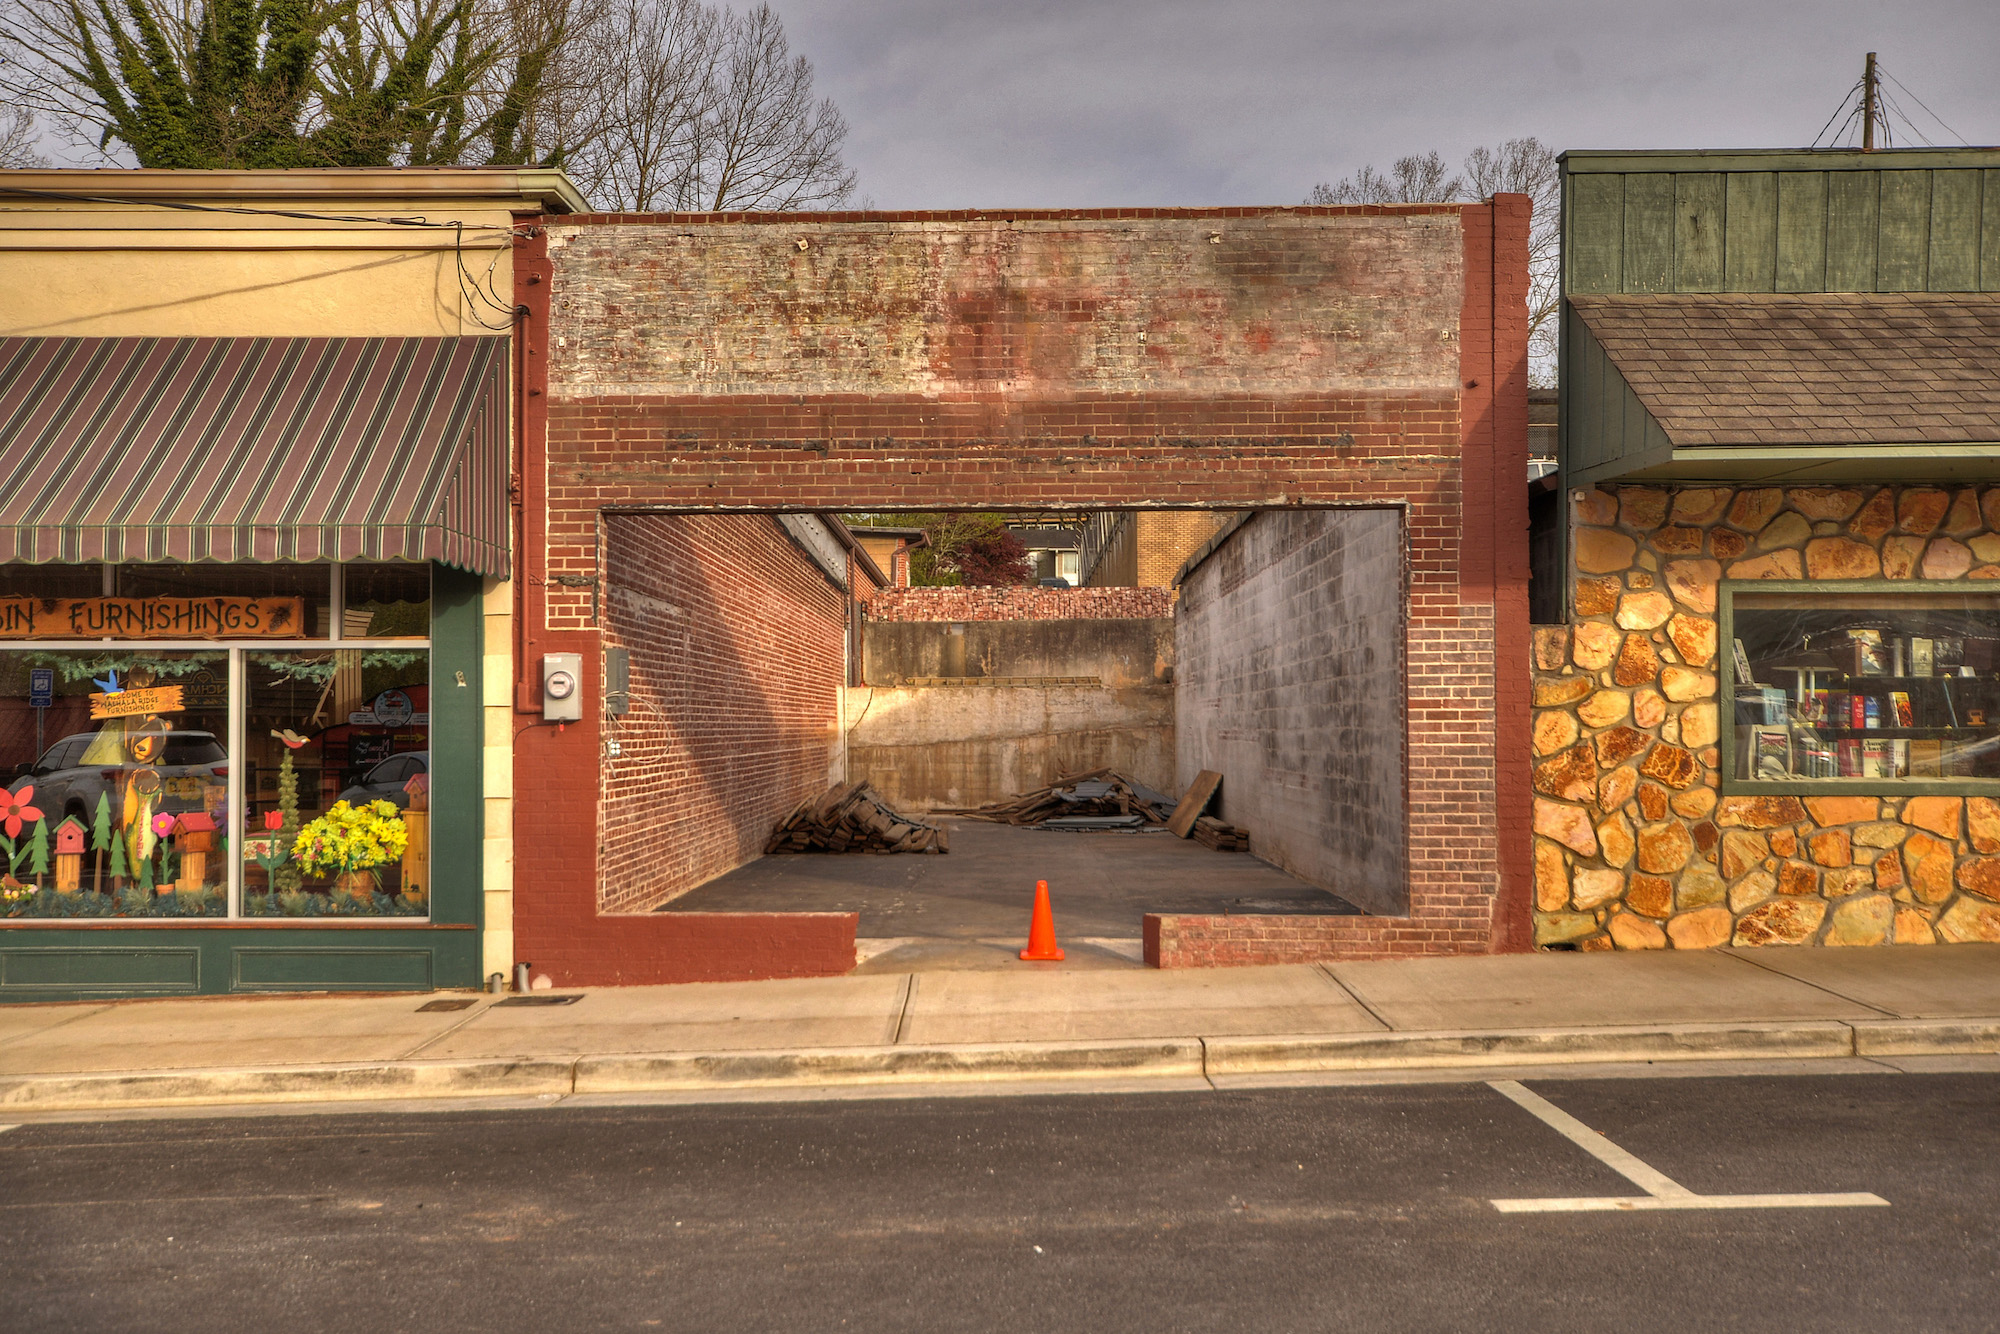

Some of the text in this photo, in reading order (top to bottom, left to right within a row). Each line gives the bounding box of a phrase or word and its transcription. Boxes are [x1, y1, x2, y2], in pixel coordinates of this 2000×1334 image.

[0, 600, 260, 633] IN FURNISHINGS
[138, 696, 159, 704] RIDGE
[107, 704, 154, 714] FURNISHINGS
